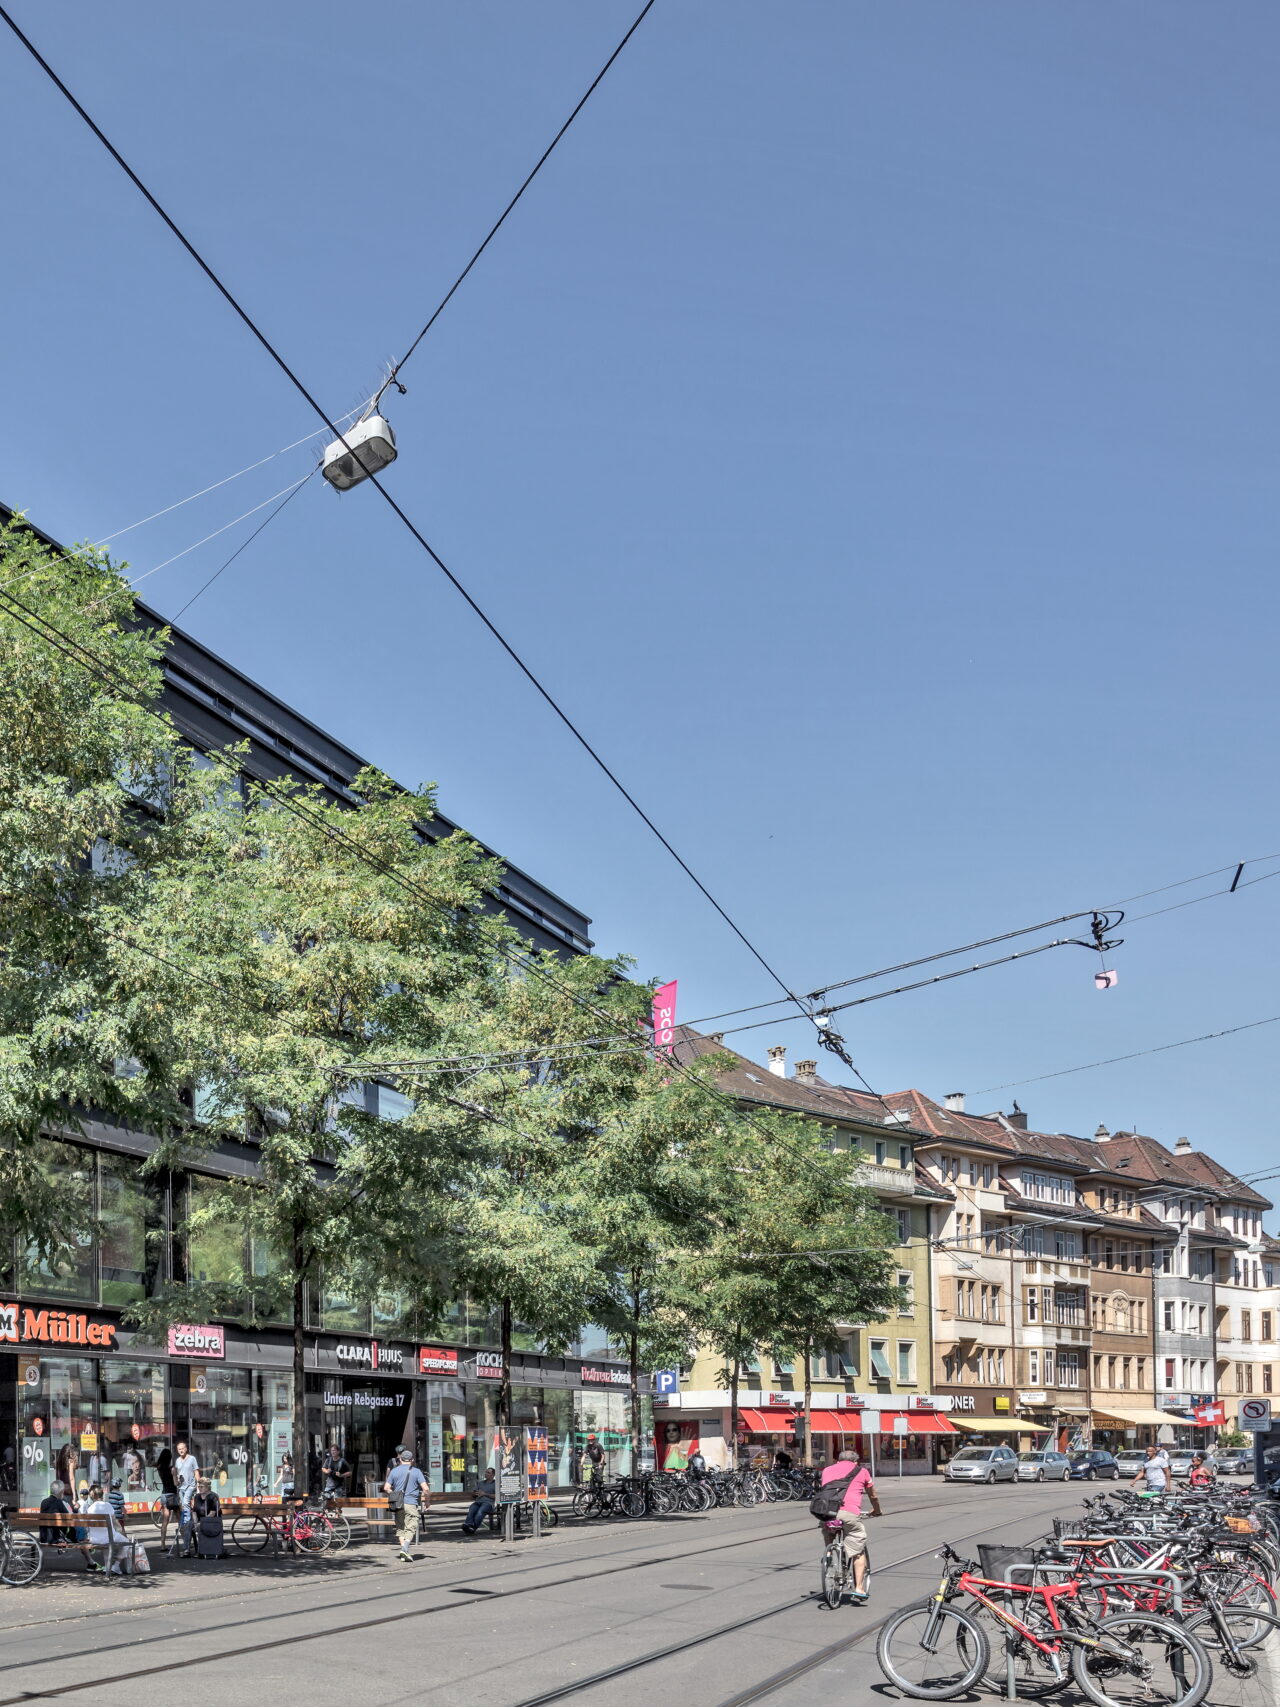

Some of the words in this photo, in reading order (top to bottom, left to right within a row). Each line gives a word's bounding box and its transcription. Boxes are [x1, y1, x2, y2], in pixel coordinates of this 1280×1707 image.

[22, 1308, 115, 1345] Müller
[175, 1330, 221, 1350] zebra
[336, 1344, 371, 1361] CLARA
[378, 1348, 403, 1363] HUUS
[476, 1351, 503, 1368] KOCH
[660, 1374, 673, 1392] P
[323, 1391, 353, 1405] Untere
[354, 1391, 394, 1409] Rebgasse
[395, 1394, 405, 1406] 17
[450, 1458, 466, 1472] SALE
